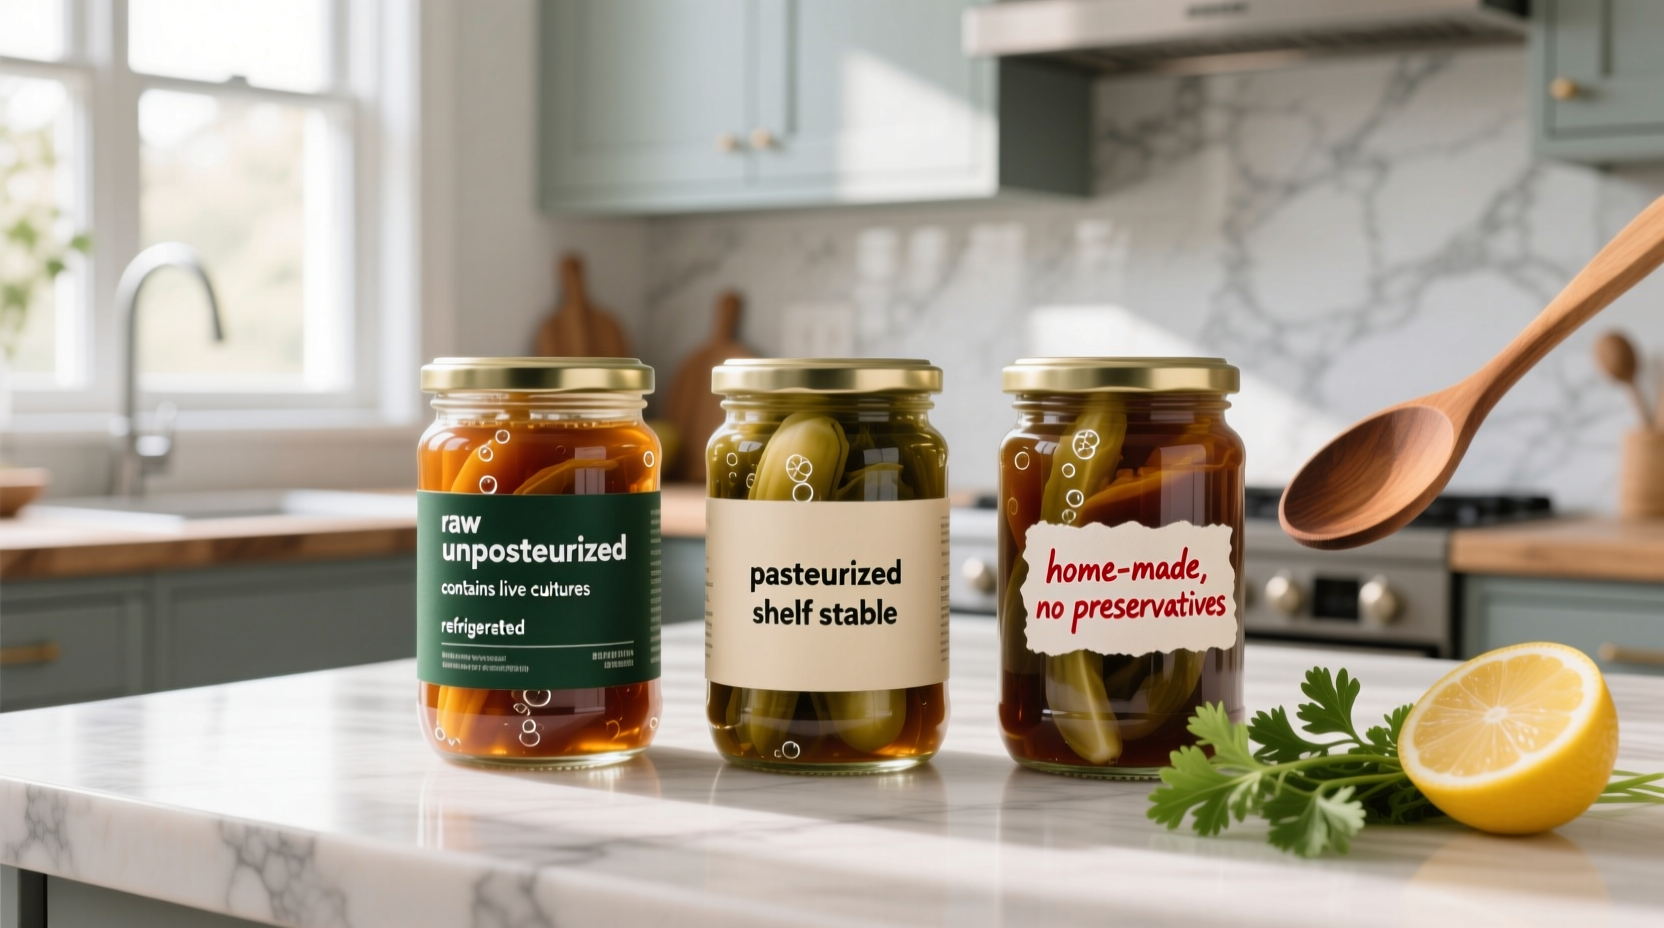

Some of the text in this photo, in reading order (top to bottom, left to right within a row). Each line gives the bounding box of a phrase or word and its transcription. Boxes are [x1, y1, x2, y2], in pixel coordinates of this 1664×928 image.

[441, 514, 481, 534] raw
[442, 533, 626, 570] unposteurized
[1046, 547, 1207, 584] home-made,
[441, 580, 495, 596] contains
[500, 580, 526, 596] live
[750, 559, 901, 592] pasteurized
[752, 599, 897, 625] shelf stable
[1036, 591, 1226, 634] no preservatives
